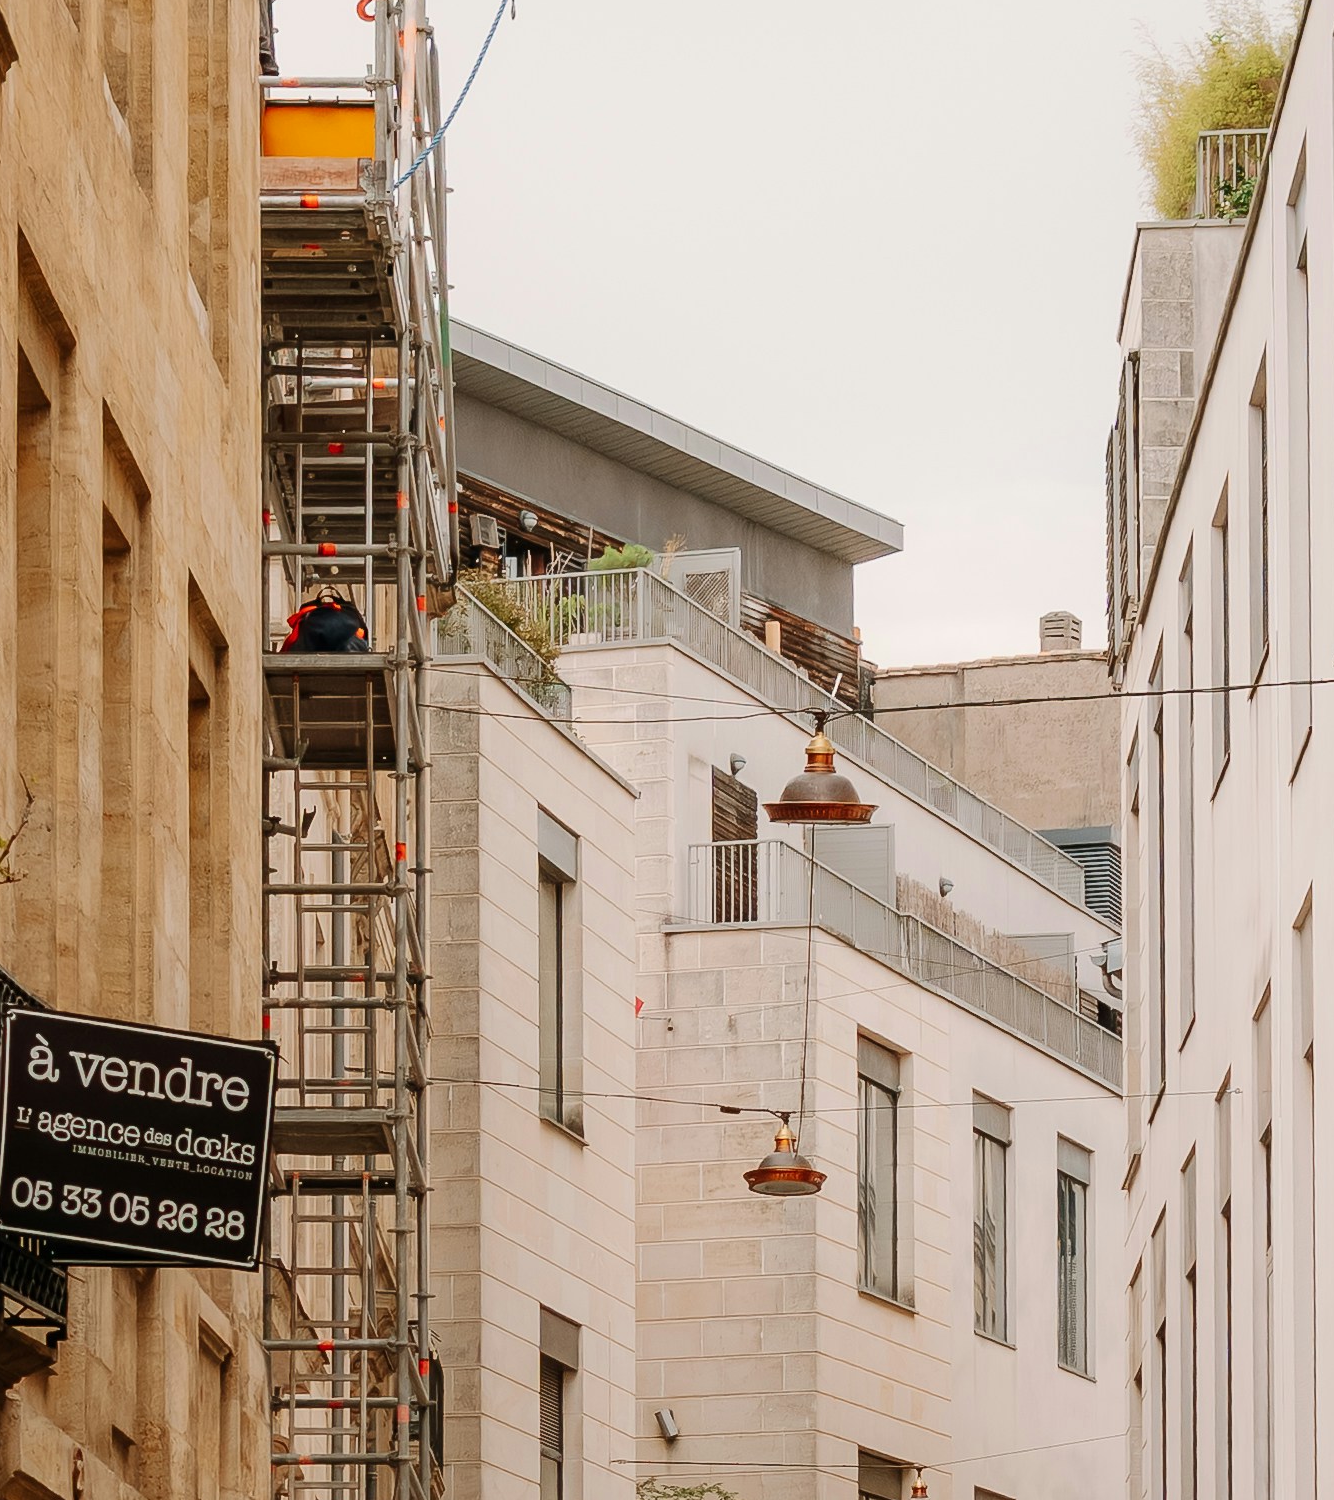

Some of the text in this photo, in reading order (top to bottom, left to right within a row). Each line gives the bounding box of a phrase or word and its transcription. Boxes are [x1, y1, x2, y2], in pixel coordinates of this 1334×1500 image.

[27, 1033, 250, 1112] à vendre
[144, 1127, 172, 1147] des
[176, 1128, 256, 1166] docks
[11, 1176, 245, 1240] 05 33 05 26 28
